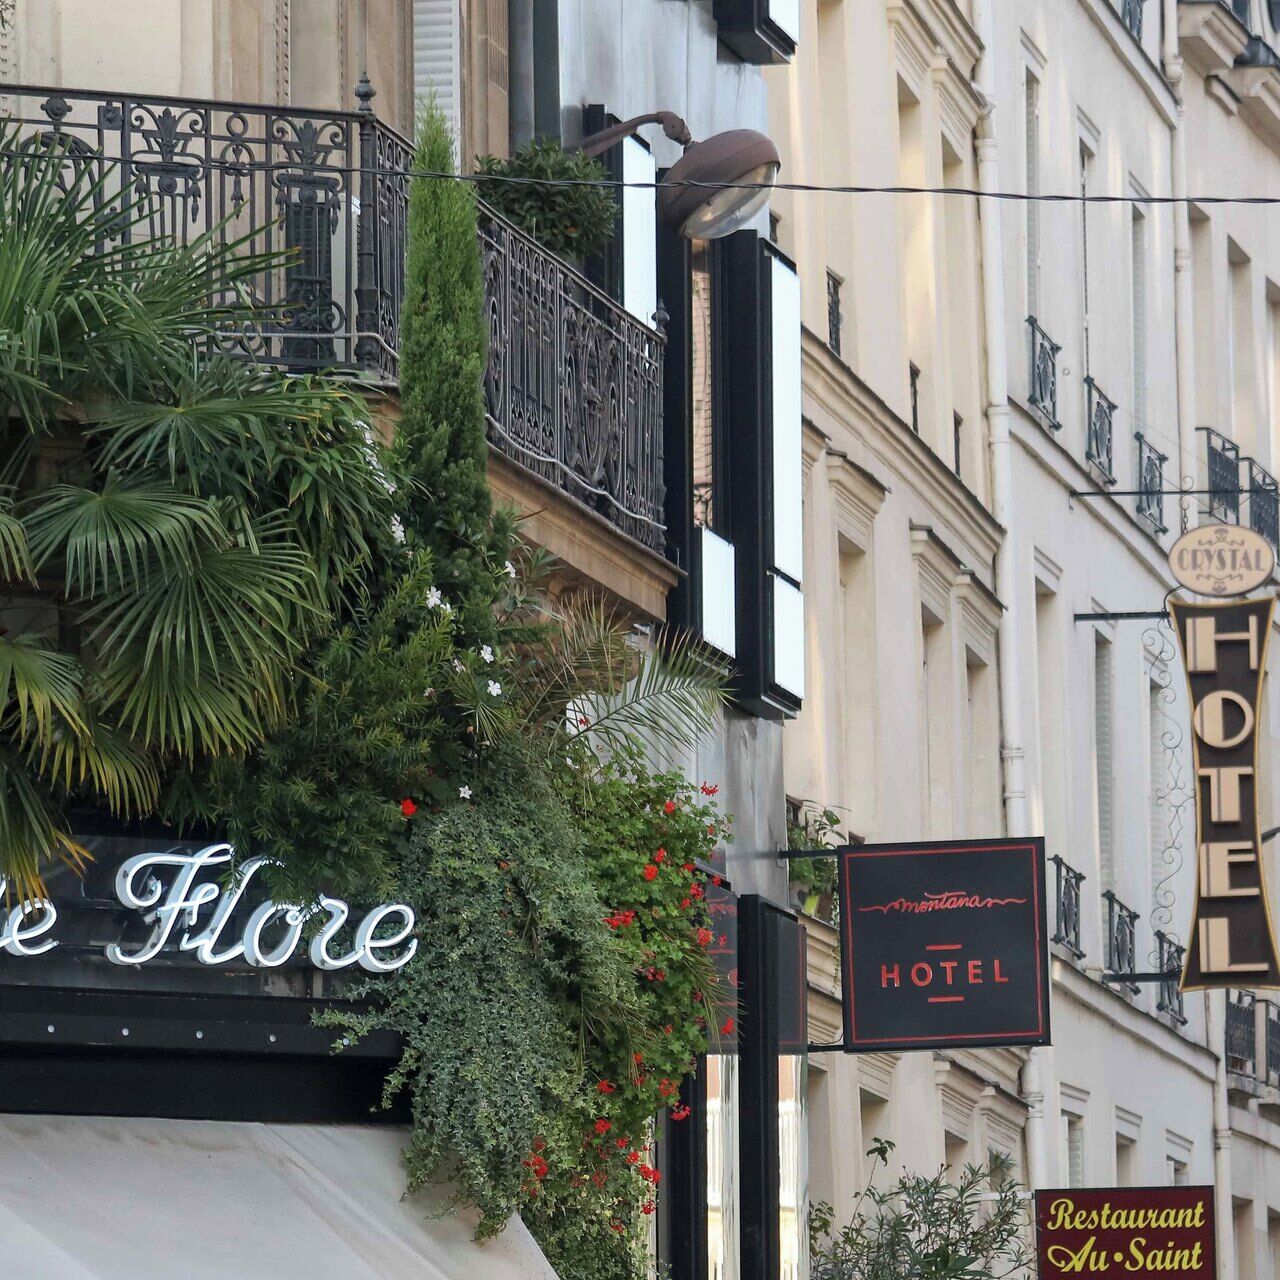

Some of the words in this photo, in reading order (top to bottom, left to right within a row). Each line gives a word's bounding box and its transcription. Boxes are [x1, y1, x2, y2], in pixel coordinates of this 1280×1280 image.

[1176, 546, 1267, 574] CRYSTAL
[1186, 613, 1269, 974] HOTEL
[104, 843, 419, 973] Flore
[859, 891, 1027, 914] montana
[880, 959, 1010, 988] HOTEL
[1047, 1198, 1206, 1231] Restaurant
[1047, 1236, 1110, 1273] Au
[1125, 1237, 1204, 1272] Saint
